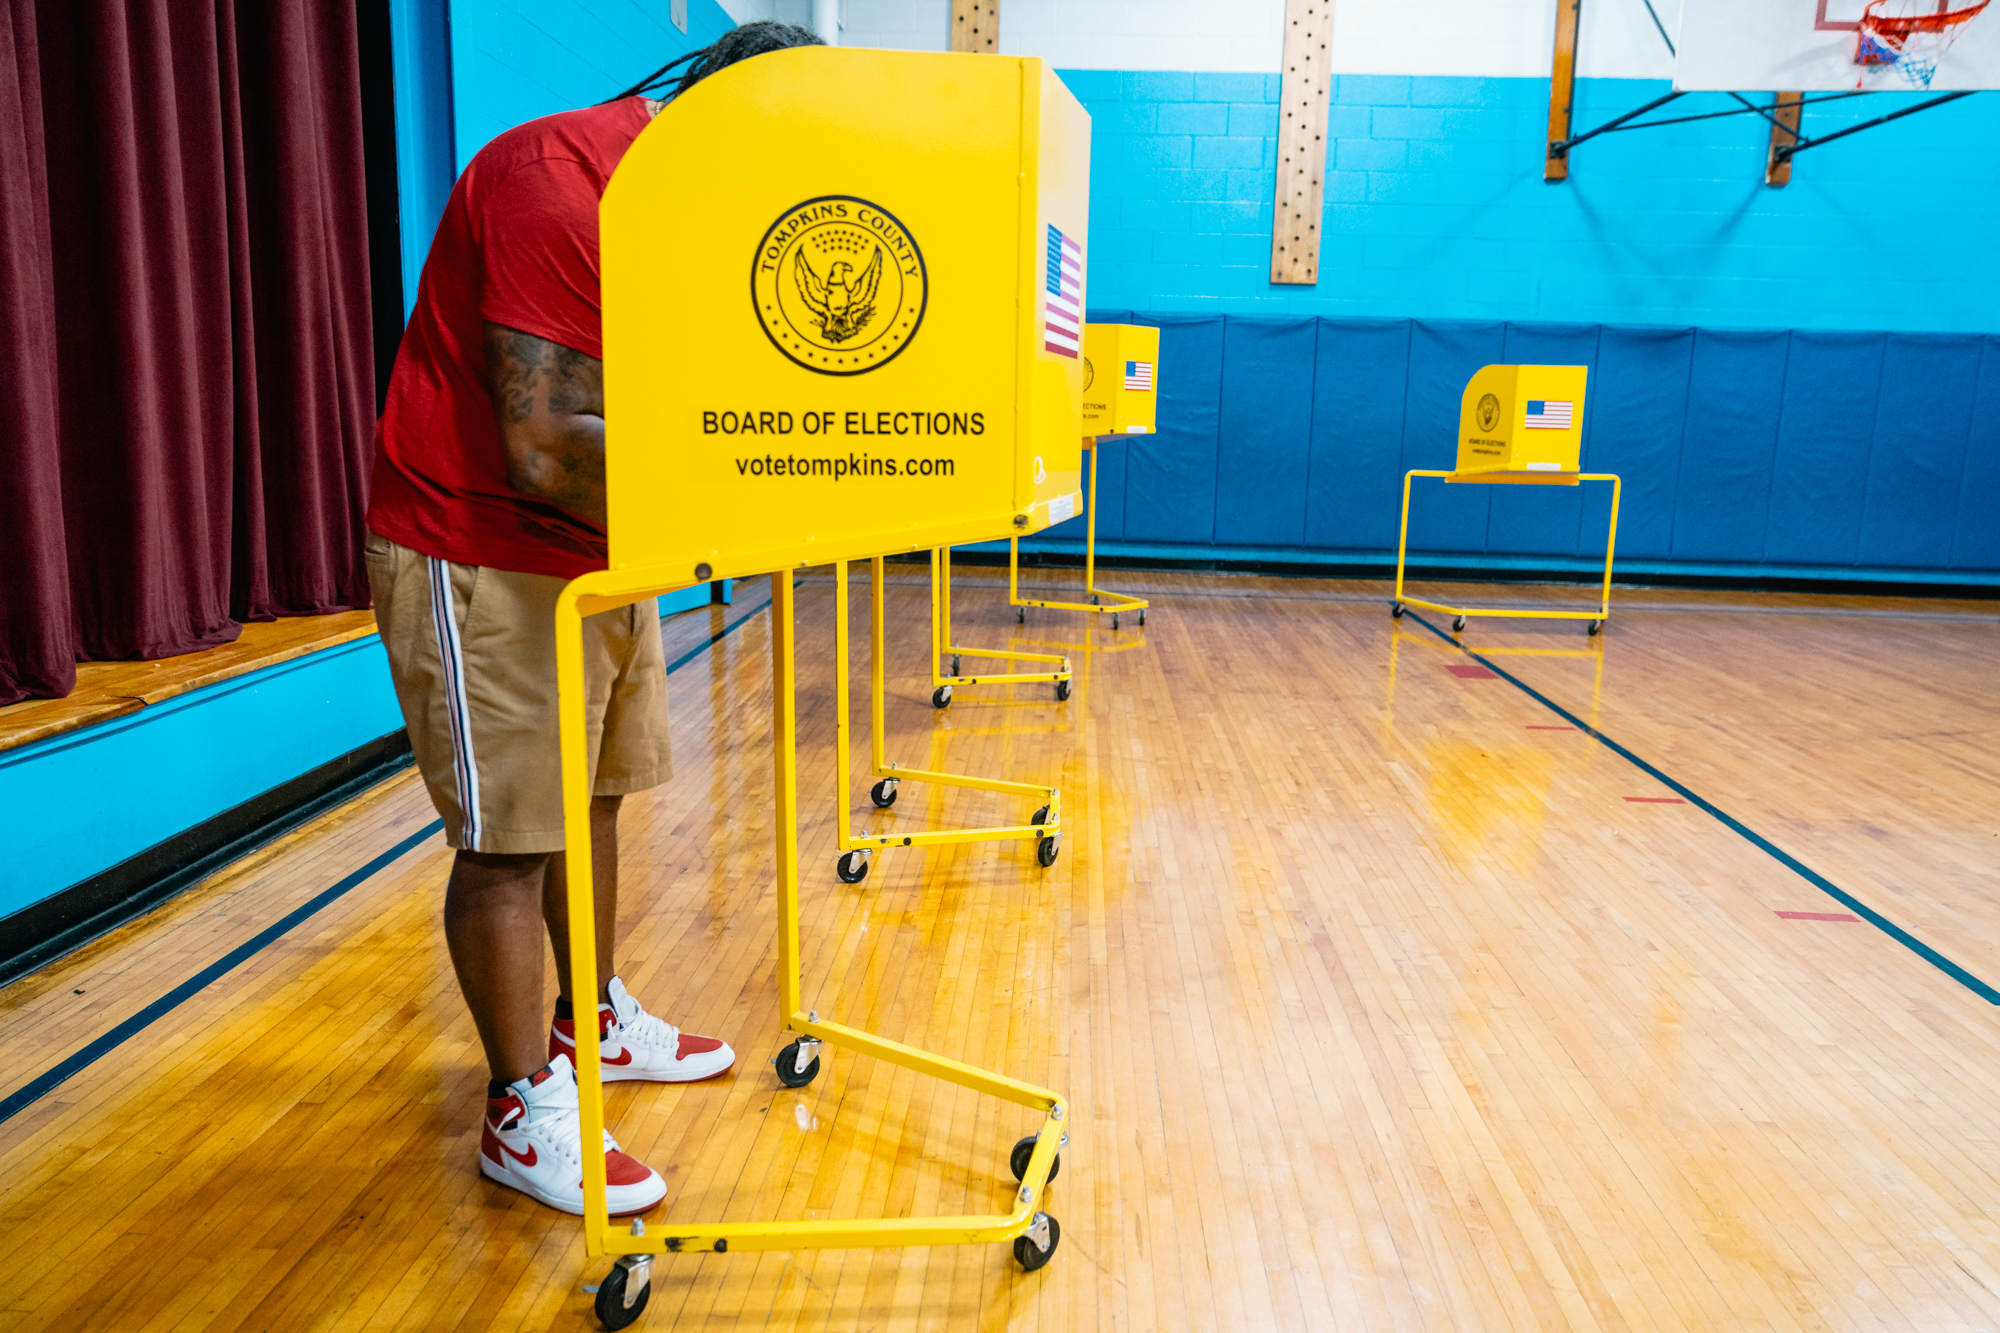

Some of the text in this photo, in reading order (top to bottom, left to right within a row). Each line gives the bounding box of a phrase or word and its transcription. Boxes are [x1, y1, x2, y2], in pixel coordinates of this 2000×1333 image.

[762, 204, 919, 278] TOMPKINS COUNTY
[703, 411, 985, 435] BOARD OF ELECTIONS
[736, 453, 954, 481] votetompkins.com
